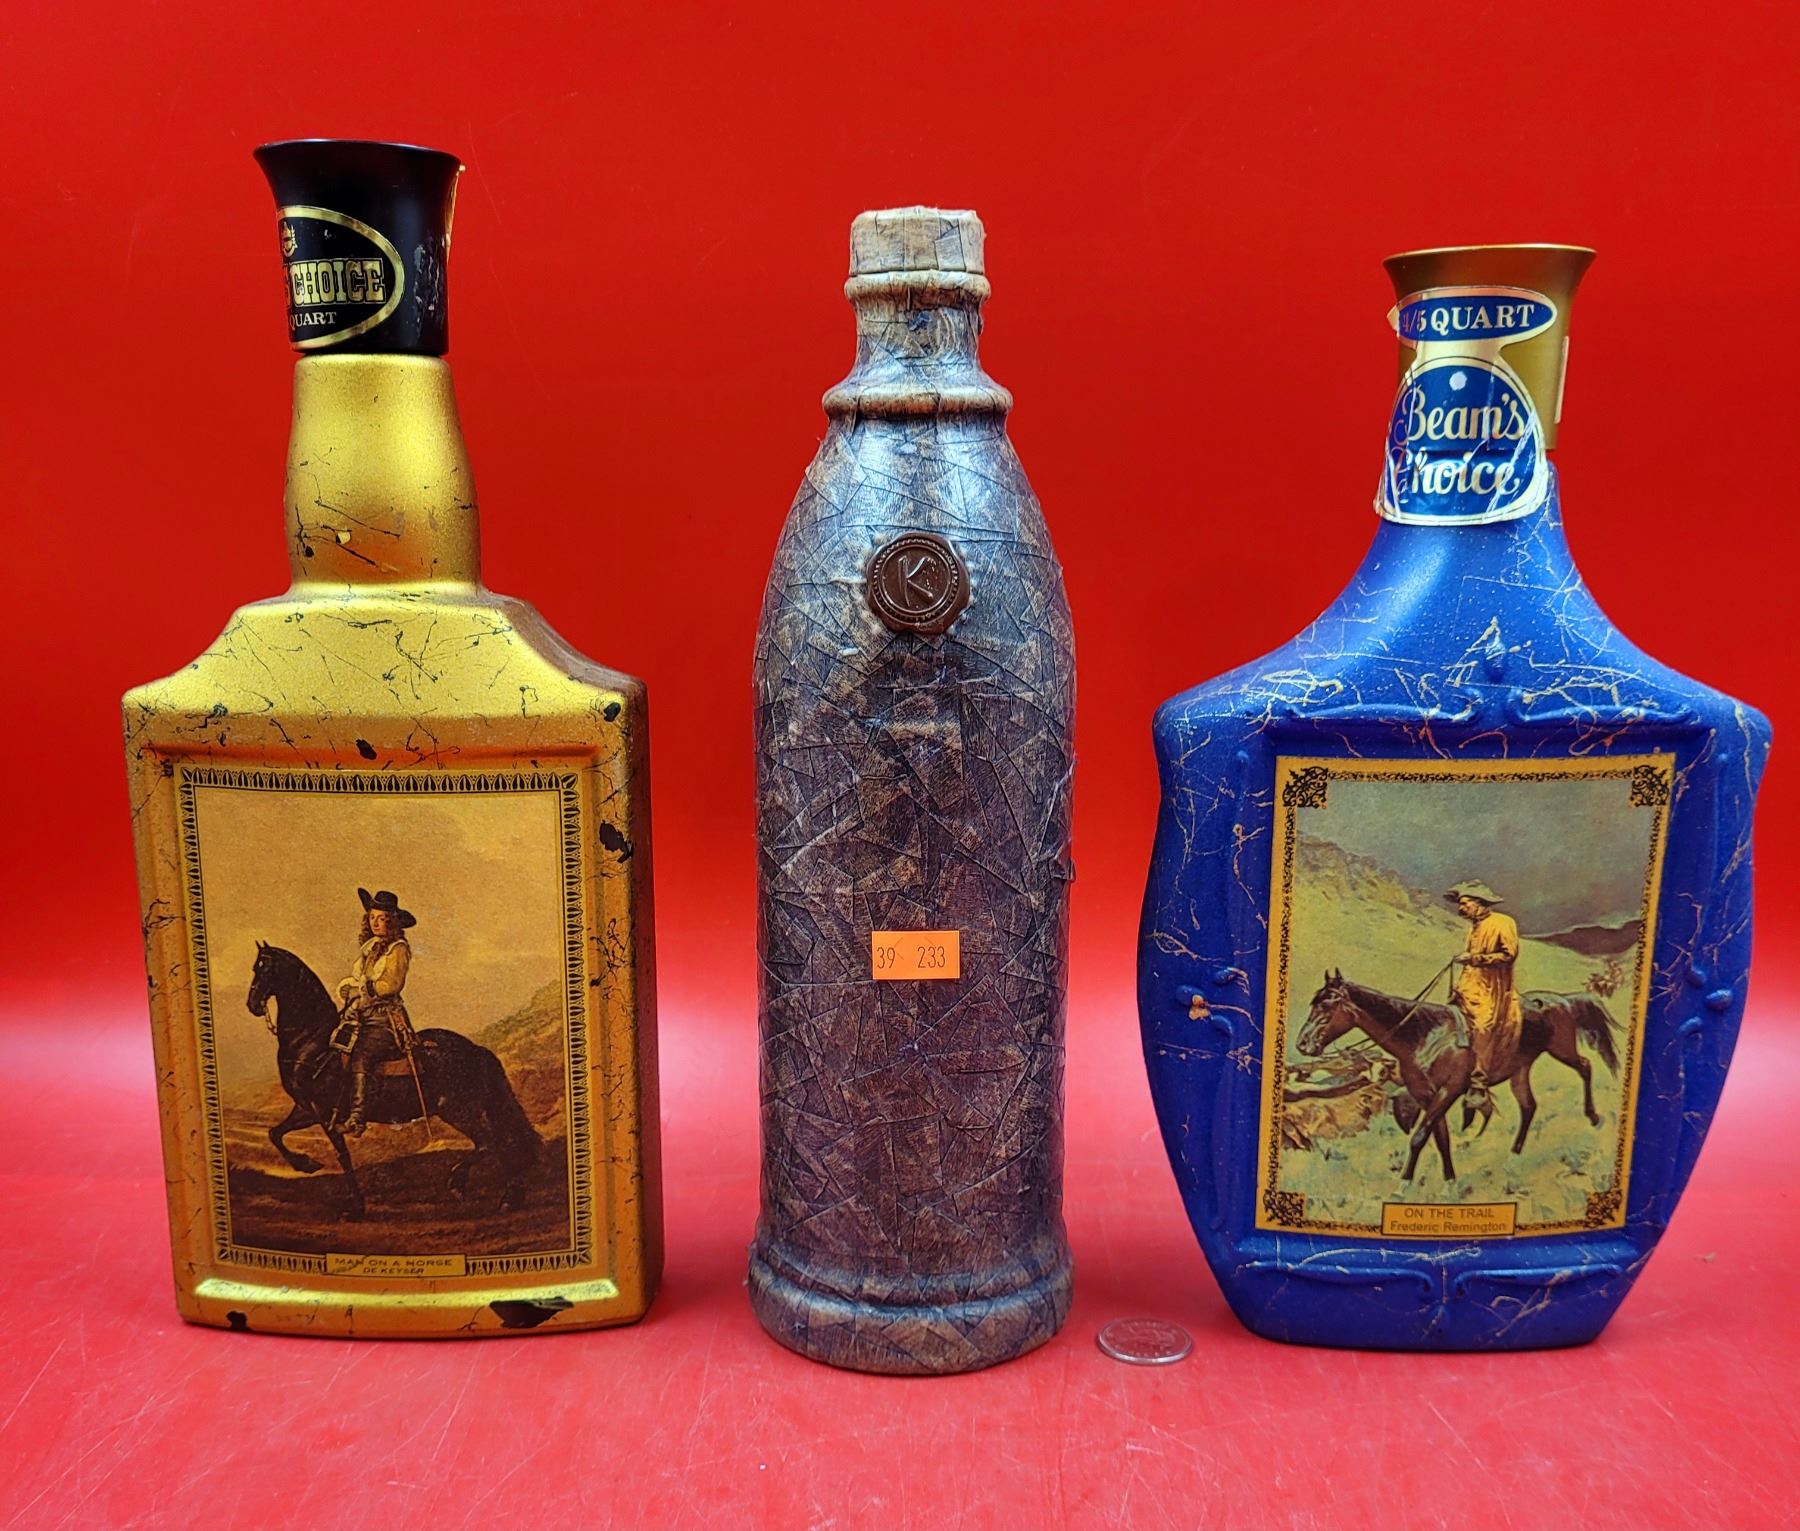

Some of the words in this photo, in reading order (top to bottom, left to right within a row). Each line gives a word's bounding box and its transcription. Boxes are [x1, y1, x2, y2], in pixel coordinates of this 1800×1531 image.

[289, 258, 386, 307] CHOICE
[289, 312, 337, 330] QUART
[1402, 308, 1427, 332] 4/5
[1431, 304, 1535, 336] QUART
[1393, 384, 1525, 447] Beam's
[1390, 446, 1521, 500] Choice
[898, 555, 937, 608] K
[876, 946, 896, 969] 39
[917, 945, 946, 969] 233
[1404, 1207, 1424, 1219] ON
[1428, 1207, 1454, 1219] THE
[1458, 1207, 1495, 1218] TRAIL
[1390, 1220, 1436, 1232] Frederic
[1443, 1220, 1506, 1233] Remington
[334, 1257, 364, 1266] MAN
[369, 1258, 388, 1267] ON
[393, 1258, 402, 1267] A
[406, 1257, 453, 1267] HORSE
[362, 1266, 375, 1274] DE
[380, 1266, 426, 1274] KEYSER
